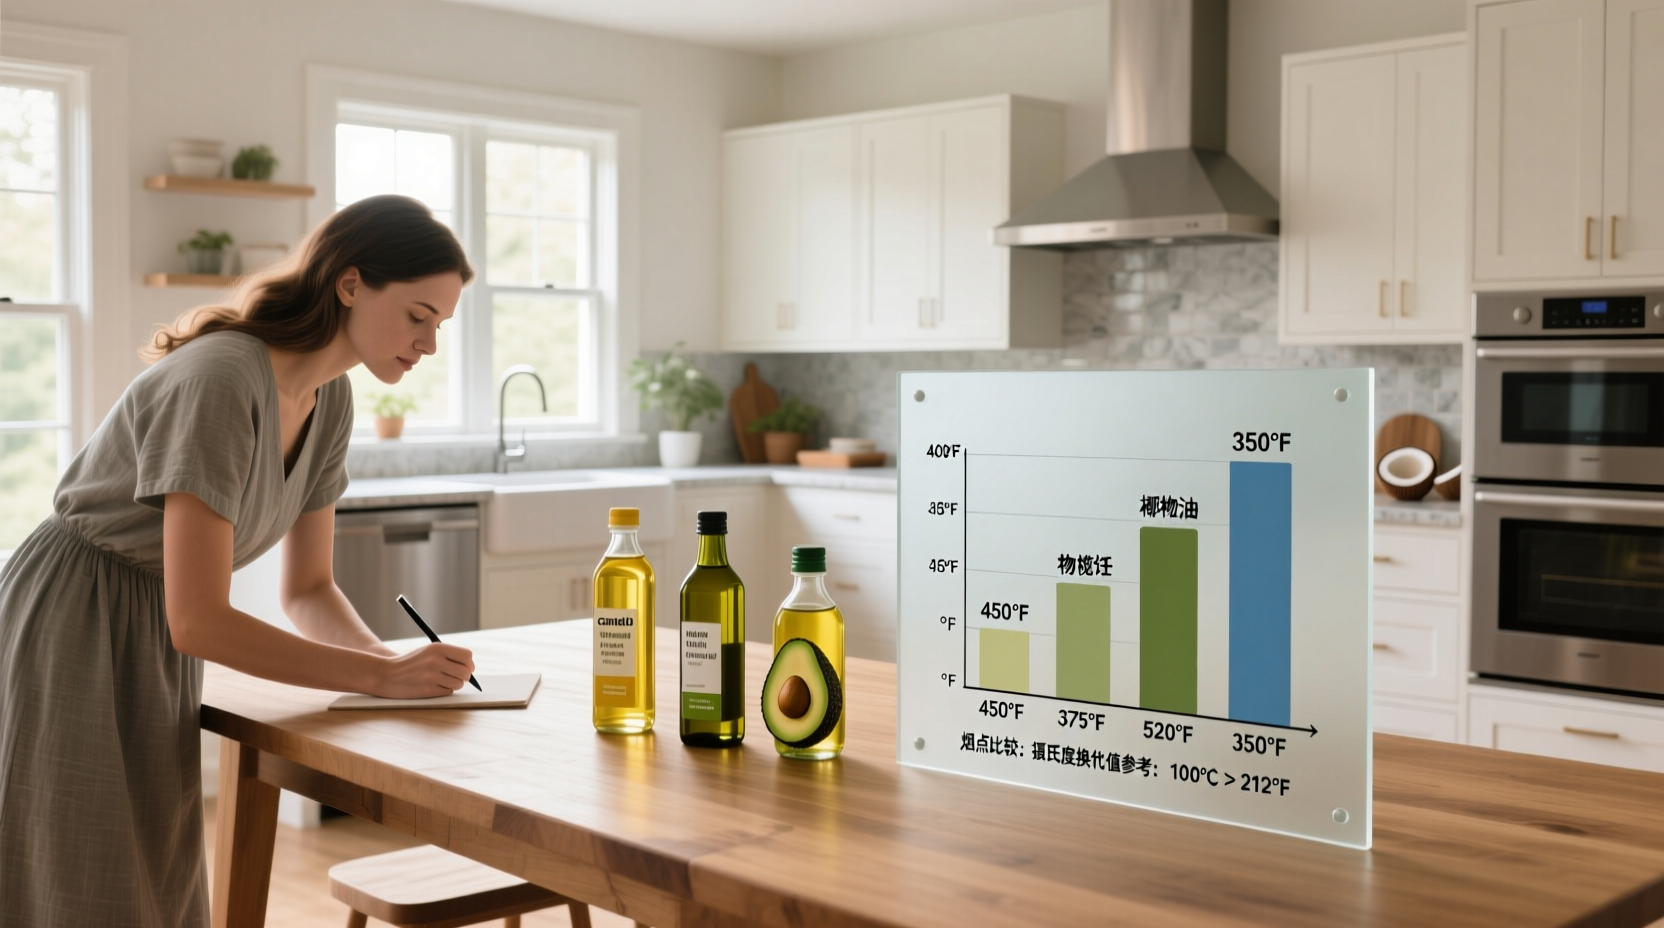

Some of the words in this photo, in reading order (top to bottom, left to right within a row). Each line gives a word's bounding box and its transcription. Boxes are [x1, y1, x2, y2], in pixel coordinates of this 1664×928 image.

[1232, 431, 1292, 452] 350°F
[980, 602, 1030, 622] 450°F
[978, 699, 1025, 720] 450°F
[1057, 709, 1106, 731] 375°F
[1143, 720, 1194, 743] 520°F
[1232, 732, 1287, 757] 350°F
[1170, 763, 1219, 787] 100°C
[1240, 773, 1291, 796] 212°F
